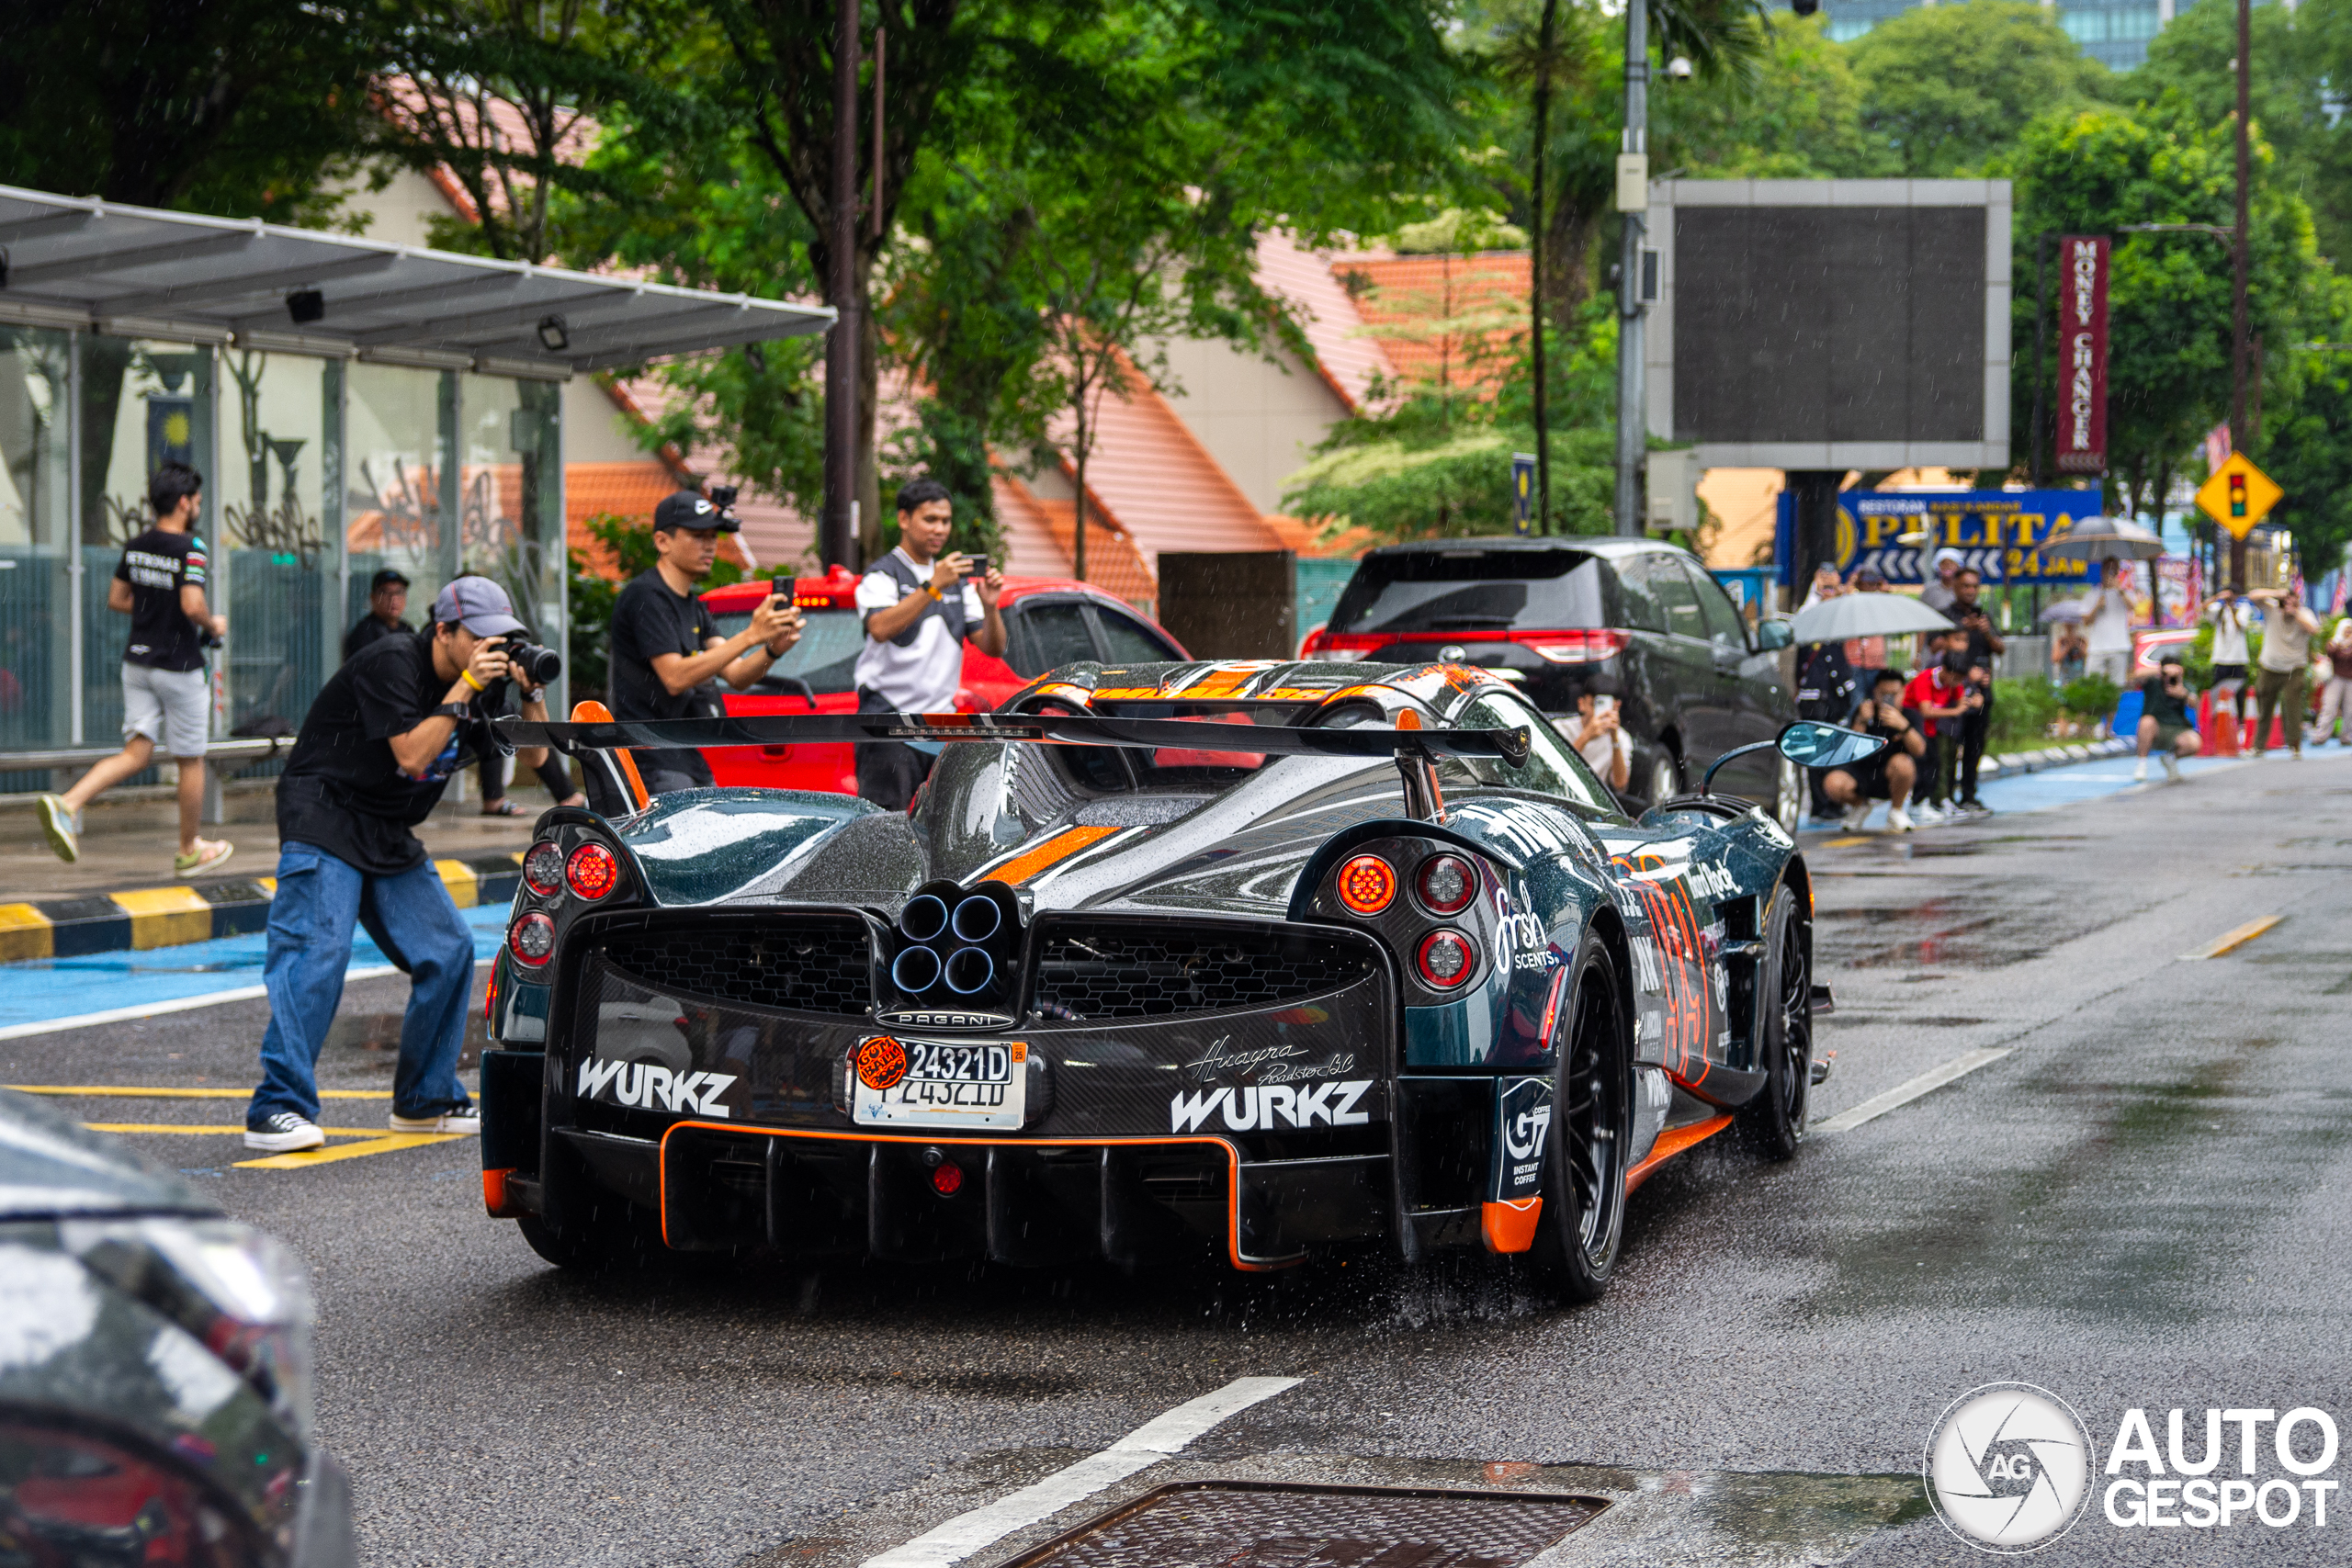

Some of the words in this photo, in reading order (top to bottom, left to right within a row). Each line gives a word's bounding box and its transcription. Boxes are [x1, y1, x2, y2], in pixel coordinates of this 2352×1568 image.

[2075, 241, 2098, 326] MONEY
[2071, 332, 2094, 451] CHANGER
[1858, 499, 1927, 515] RESTORAN
[2006, 548, 2040, 577] 24
[899, 1014, 991, 1026] PAGANI
[909, 1044, 1007, 1081] 24321D
[1185, 1034, 1309, 1083] Huayra
[1258, 1064, 1327, 1087] Roadster
[1325, 1053, 1355, 1078] BC
[577, 1056, 738, 1119] WURKZ
[1170, 1079, 1374, 1134] WURKZ
[1505, 1111, 1552, 1160] G7
[1513, 1161, 1540, 1176] INSTANT
[1514, 1172, 1537, 1186] COFFEE
